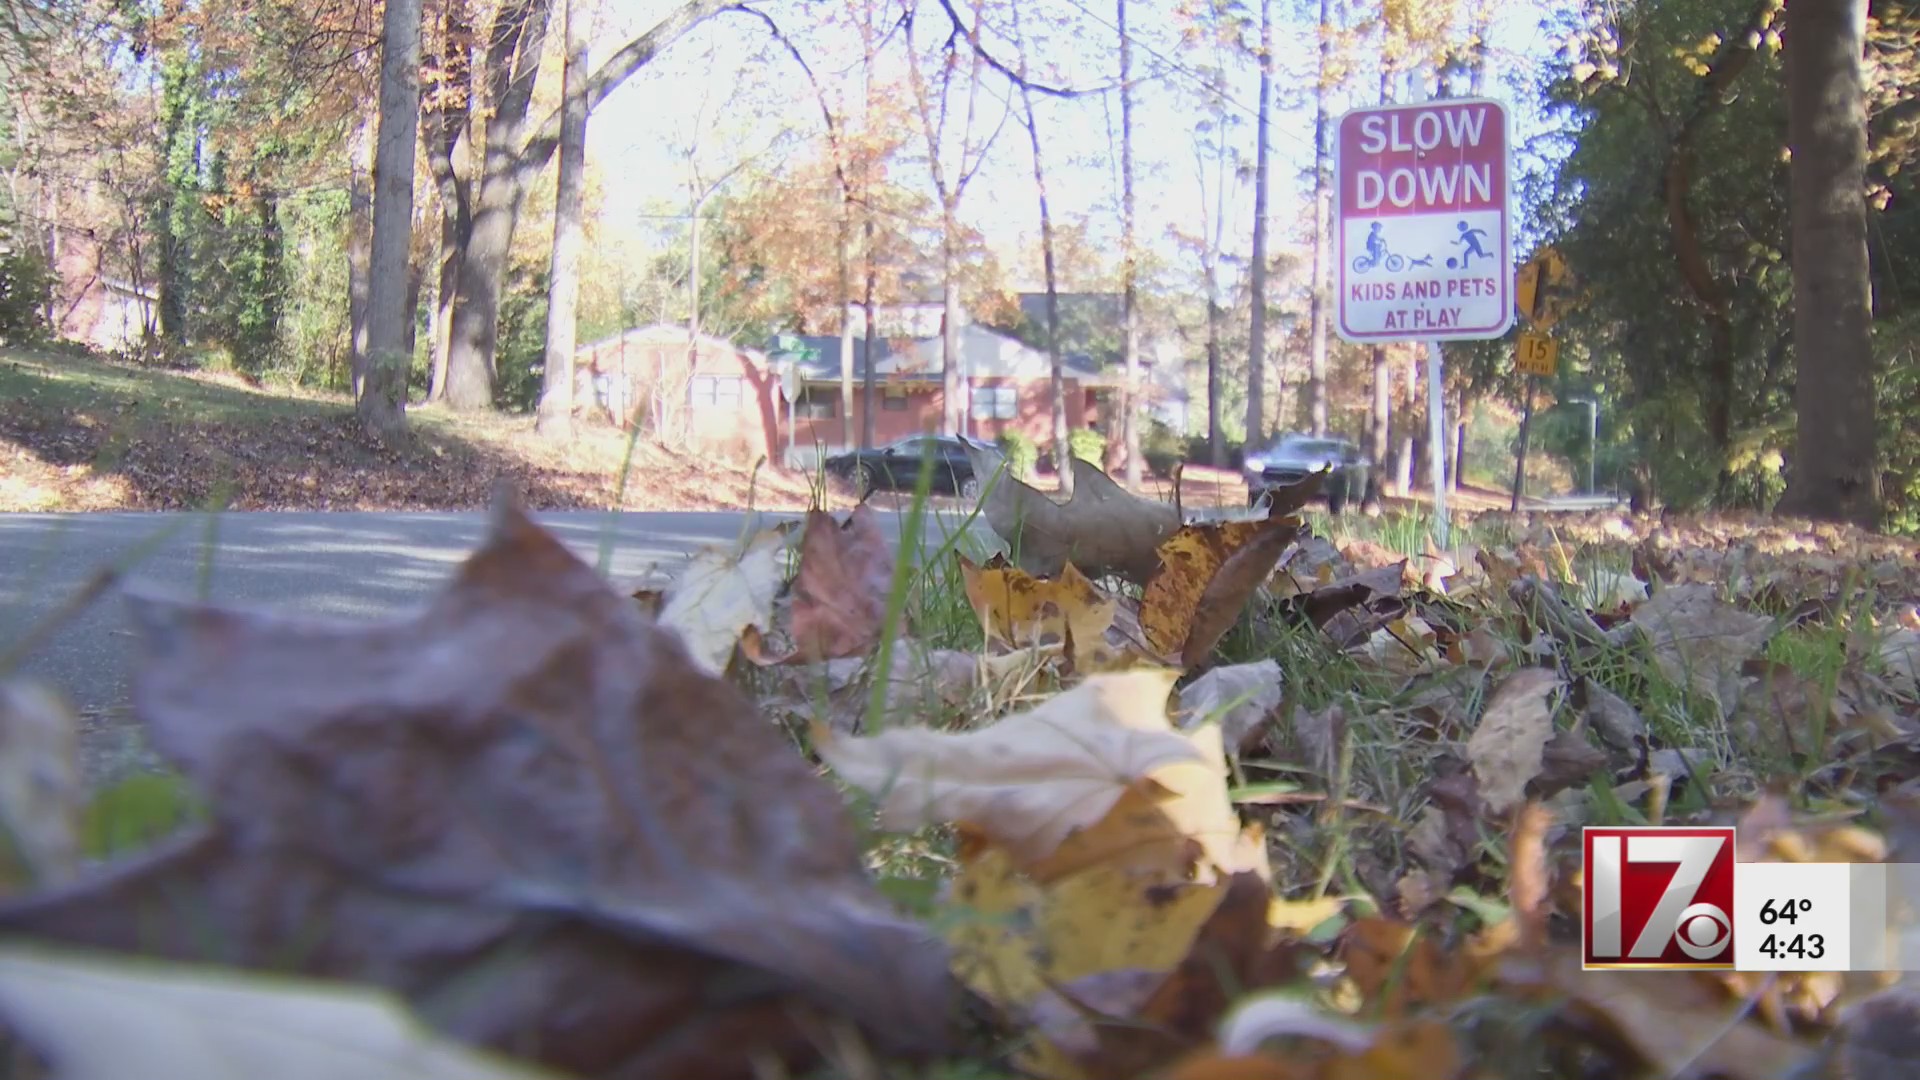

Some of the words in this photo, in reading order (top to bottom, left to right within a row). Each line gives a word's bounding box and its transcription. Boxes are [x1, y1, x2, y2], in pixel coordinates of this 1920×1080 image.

[1360, 108, 1486, 154] SLOW
[1356, 163, 1492, 209] DOWN
[1351, 282, 1396, 301] KIDS
[1402, 280, 1441, 300] AND
[1447, 278, 1497, 298] PETS
[1384, 311, 1408, 329] AT
[1413, 307, 1462, 328] PLAY
[1528, 340, 1547, 360] 15
